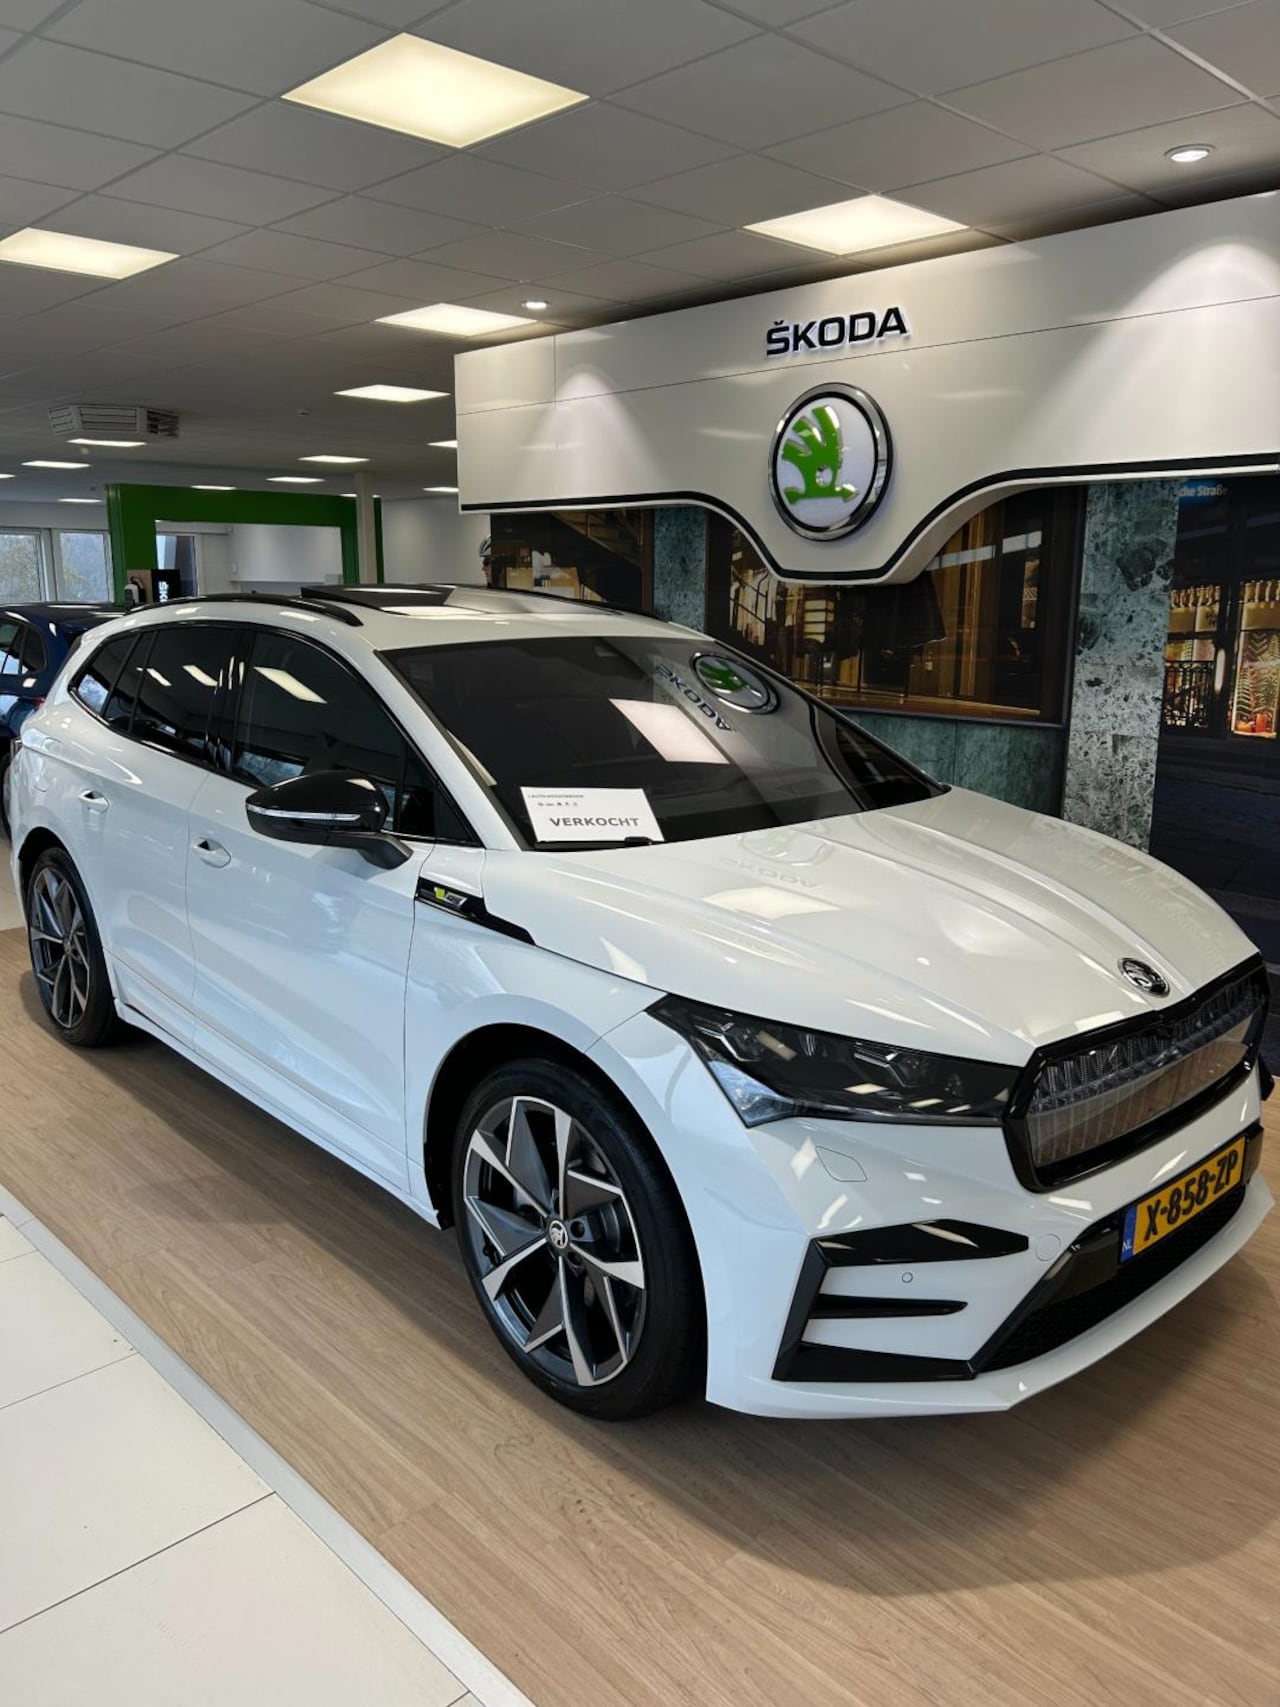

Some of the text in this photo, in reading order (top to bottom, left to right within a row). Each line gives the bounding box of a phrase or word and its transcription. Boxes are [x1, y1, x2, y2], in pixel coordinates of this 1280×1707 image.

[767, 307, 907, 356] ŠKODA
[549, 817, 640, 826] VERKOCHT
[1144, 1149, 1239, 1242] X-858-ZP
